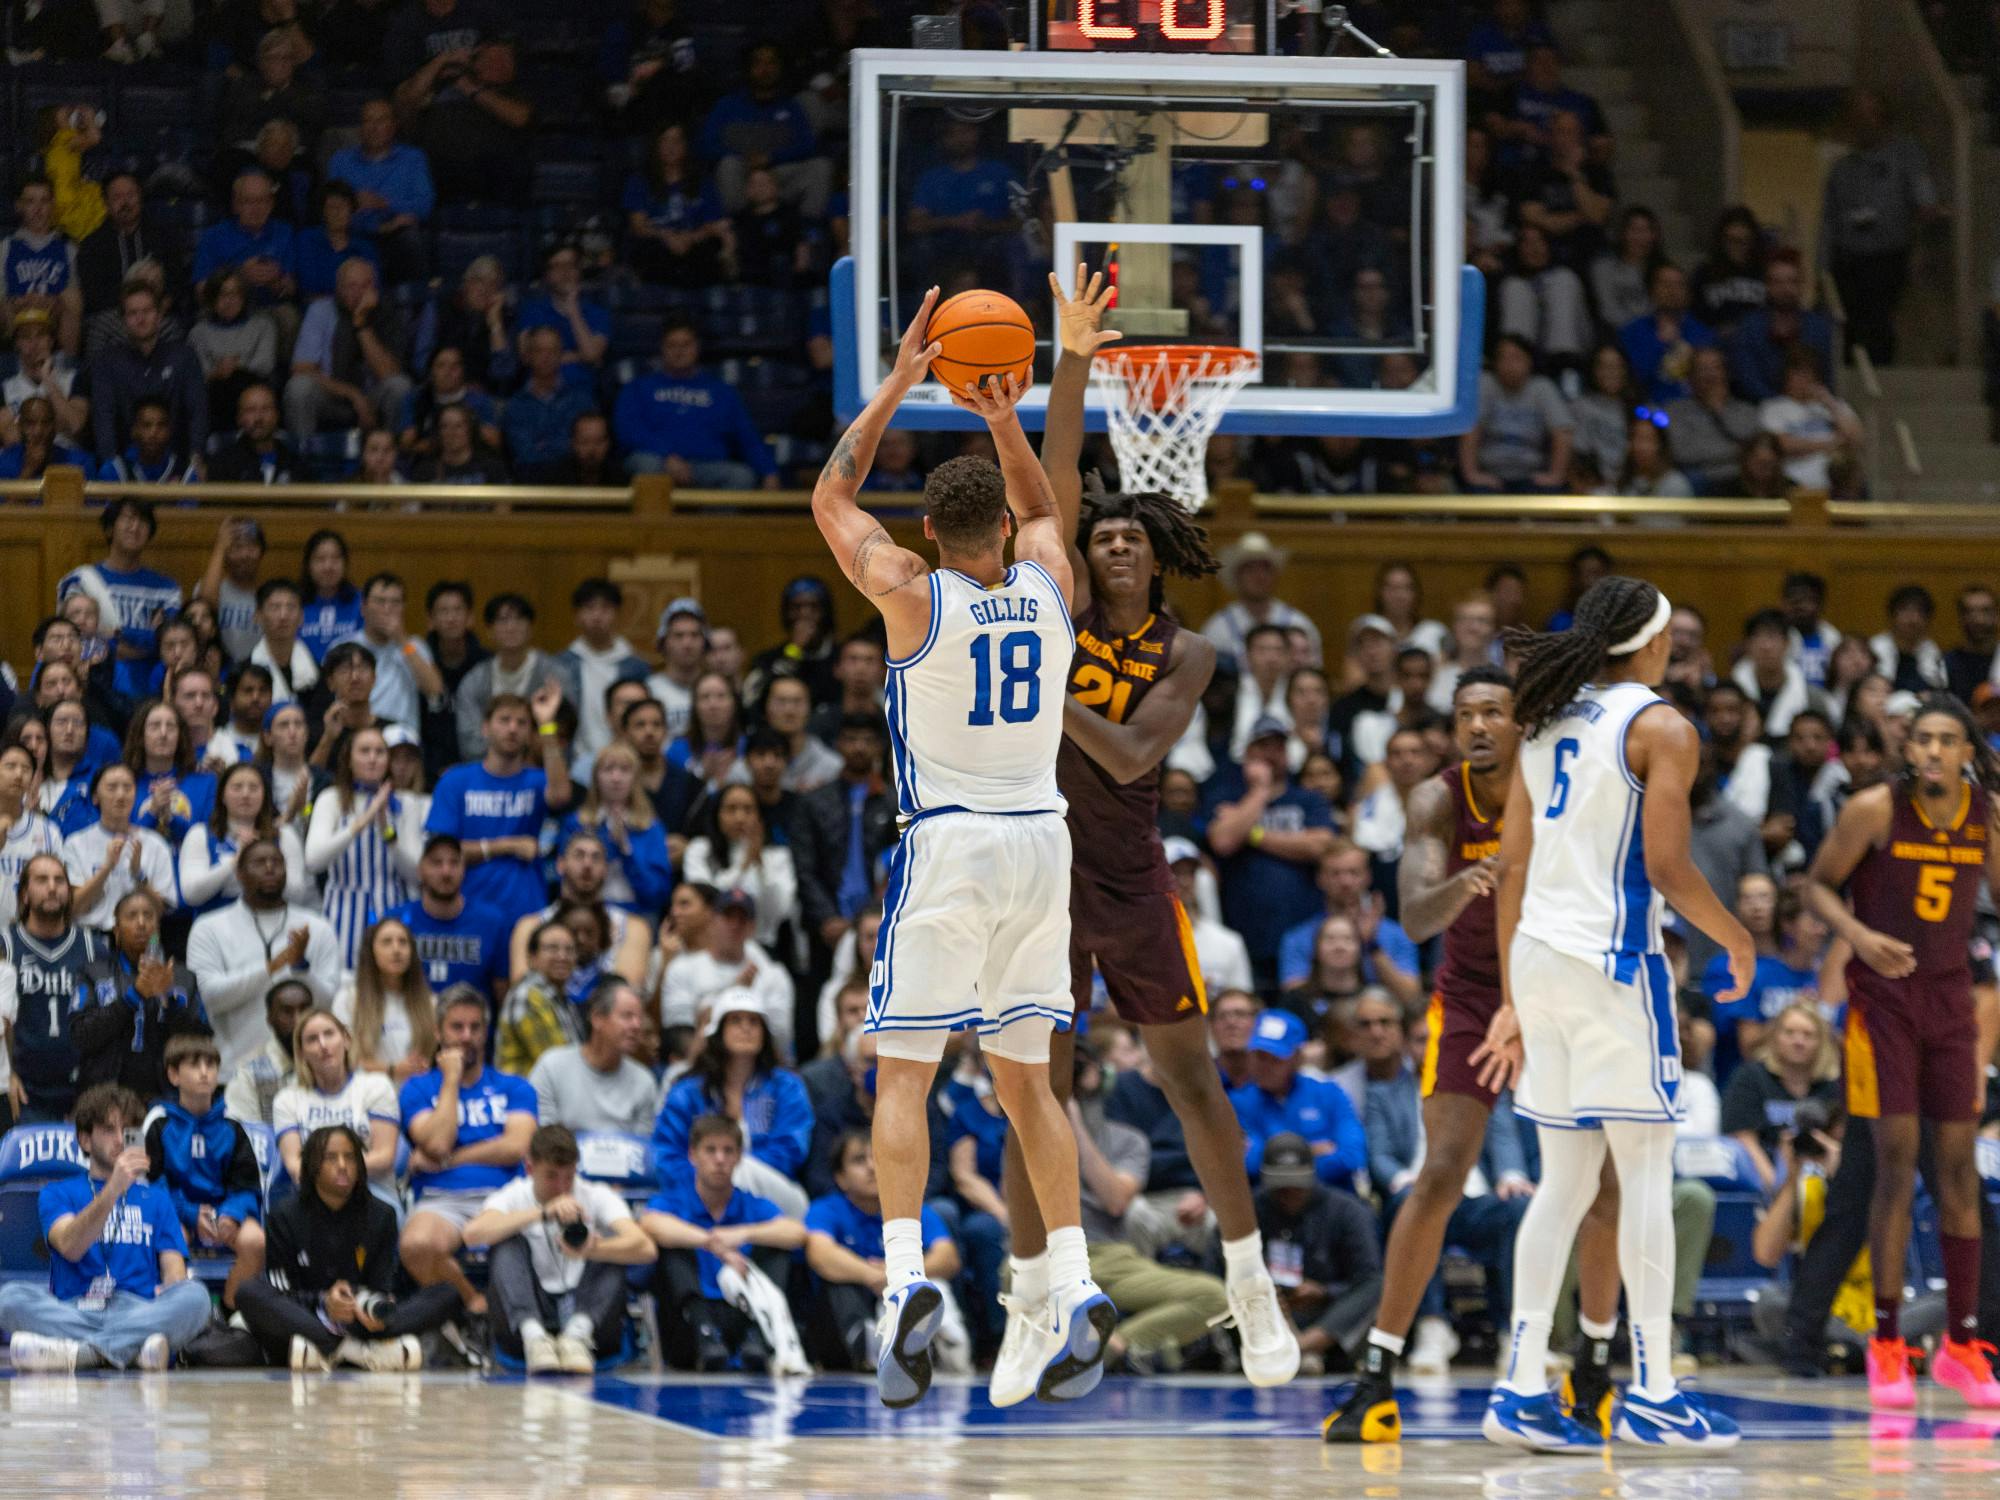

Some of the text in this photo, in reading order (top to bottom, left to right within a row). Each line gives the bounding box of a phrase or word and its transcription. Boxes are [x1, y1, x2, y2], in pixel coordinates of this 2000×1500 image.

[969, 597, 1038, 625] GILLIS
[968, 630, 1042, 726] 18
[1072, 664, 1132, 724] 21
[1121, 659, 1158, 681] STATE
[1546, 737, 1579, 818] 6
[1914, 864, 1957, 922] 5
[20, 964, 73, 997] Duk
[48, 995, 60, 1037] 1
